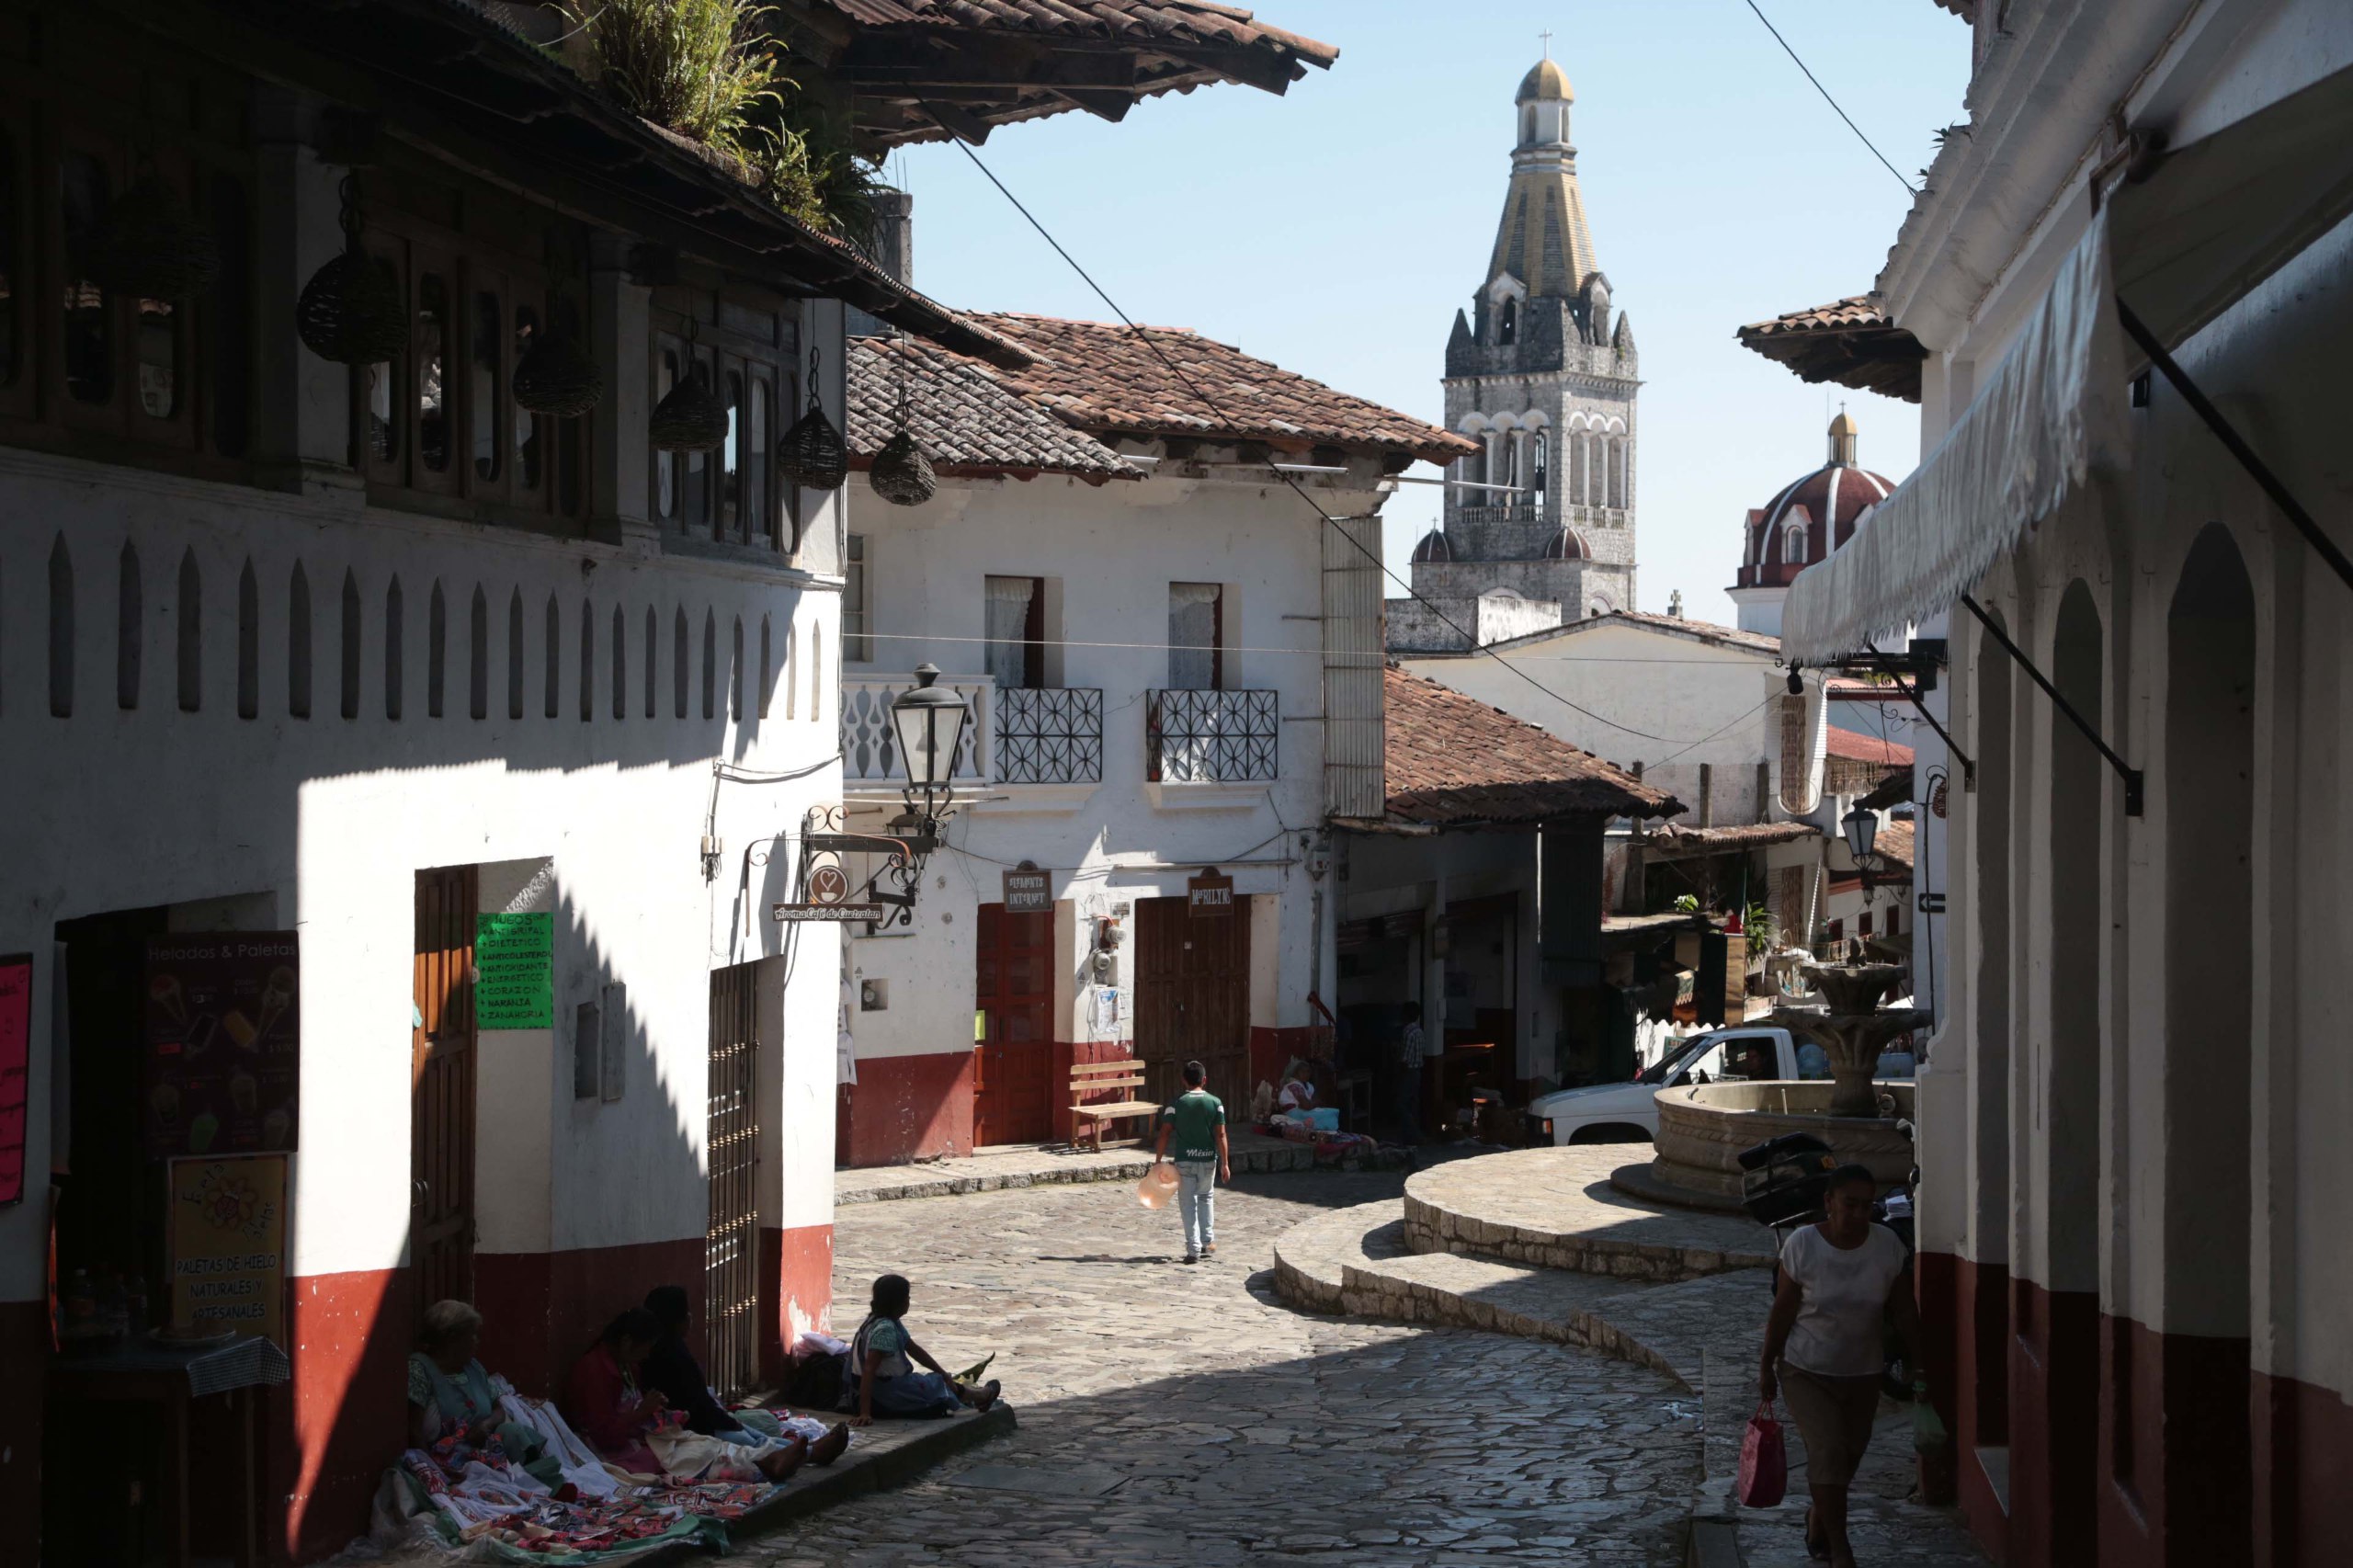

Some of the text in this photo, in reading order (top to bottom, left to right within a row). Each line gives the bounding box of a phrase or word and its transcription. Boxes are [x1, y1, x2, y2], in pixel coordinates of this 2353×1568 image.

[775, 907, 881, 921] Aroma Café de Cuetzalan
[494, 915, 534, 926] JUGOS
[488, 938, 541, 948] DIETETICO
[148, 943, 296, 960] Helados & Paletas
[486, 951, 552, 961] ANTICOLESTEROL
[487, 973, 545, 984] ENERGETICO
[487, 985, 540, 995] CORAZON
[487, 998, 531, 1007] NARANJA
[487, 1010, 545, 1019] ZANAHORIA
[176, 1255, 277, 1274] PALETAS DE HIELO
[189, 1278, 265, 1298] NATURALES Y
[191, 1302, 266, 1320] ARTESANALES
